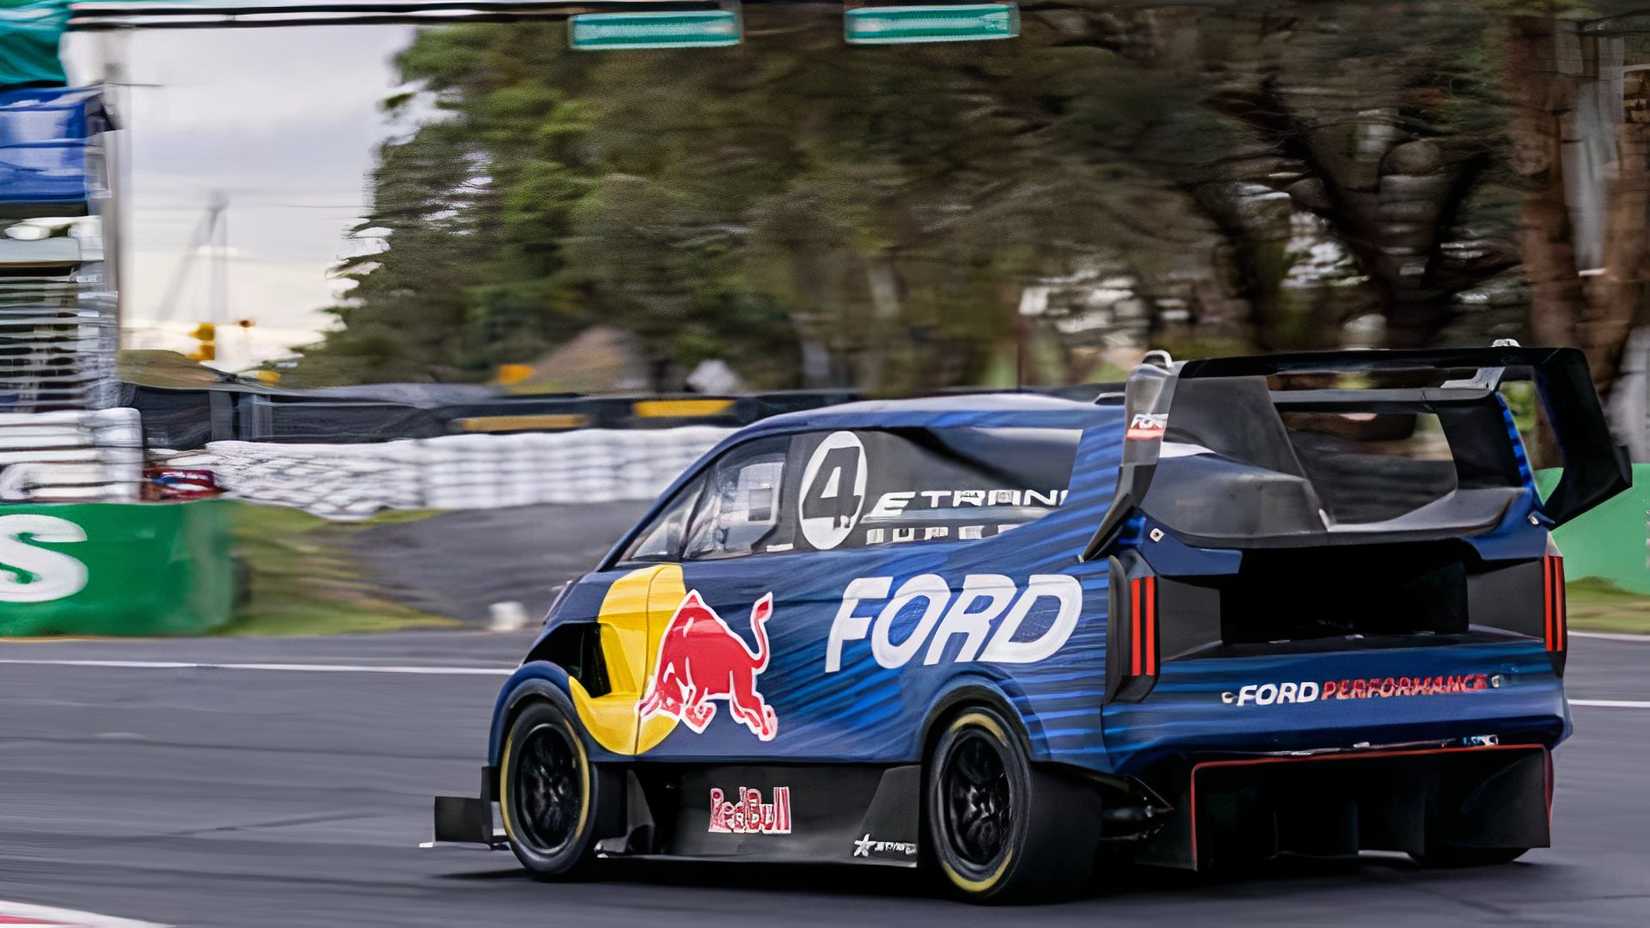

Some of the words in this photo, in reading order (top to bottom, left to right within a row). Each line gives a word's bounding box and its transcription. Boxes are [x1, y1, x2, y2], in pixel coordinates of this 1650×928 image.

[802, 446, 863, 529] 4
[825, 573, 1083, 673] FORD
[1236, 681, 1319, 706] FORD
[1321, 673, 1488, 701] PERFORMANCE
